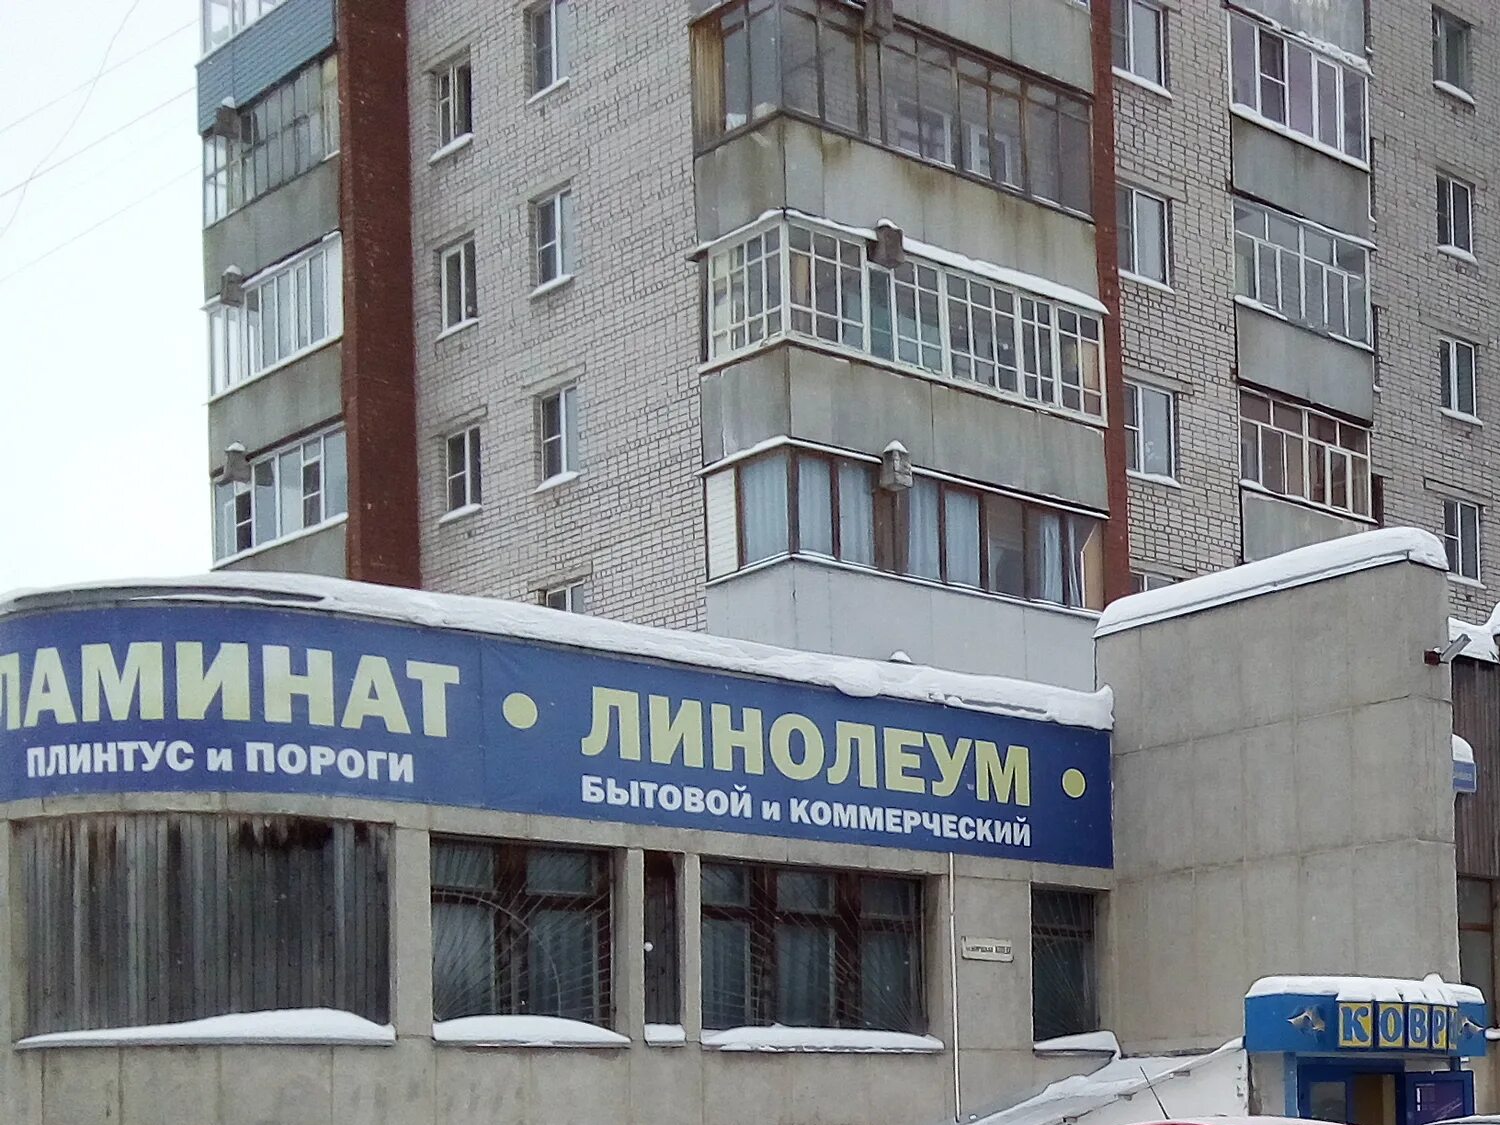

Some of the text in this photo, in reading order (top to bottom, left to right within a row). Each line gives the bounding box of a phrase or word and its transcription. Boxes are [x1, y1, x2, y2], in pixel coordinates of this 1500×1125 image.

[27, 740, 414, 783] ПЛИНТУС и ПОРОГИ
[580, 686, 1031, 806] ЛИНОЛЕУМ
[581, 774, 1031, 847] БЫТОВОЙ и КОММЕРЧЕСКИЙ
